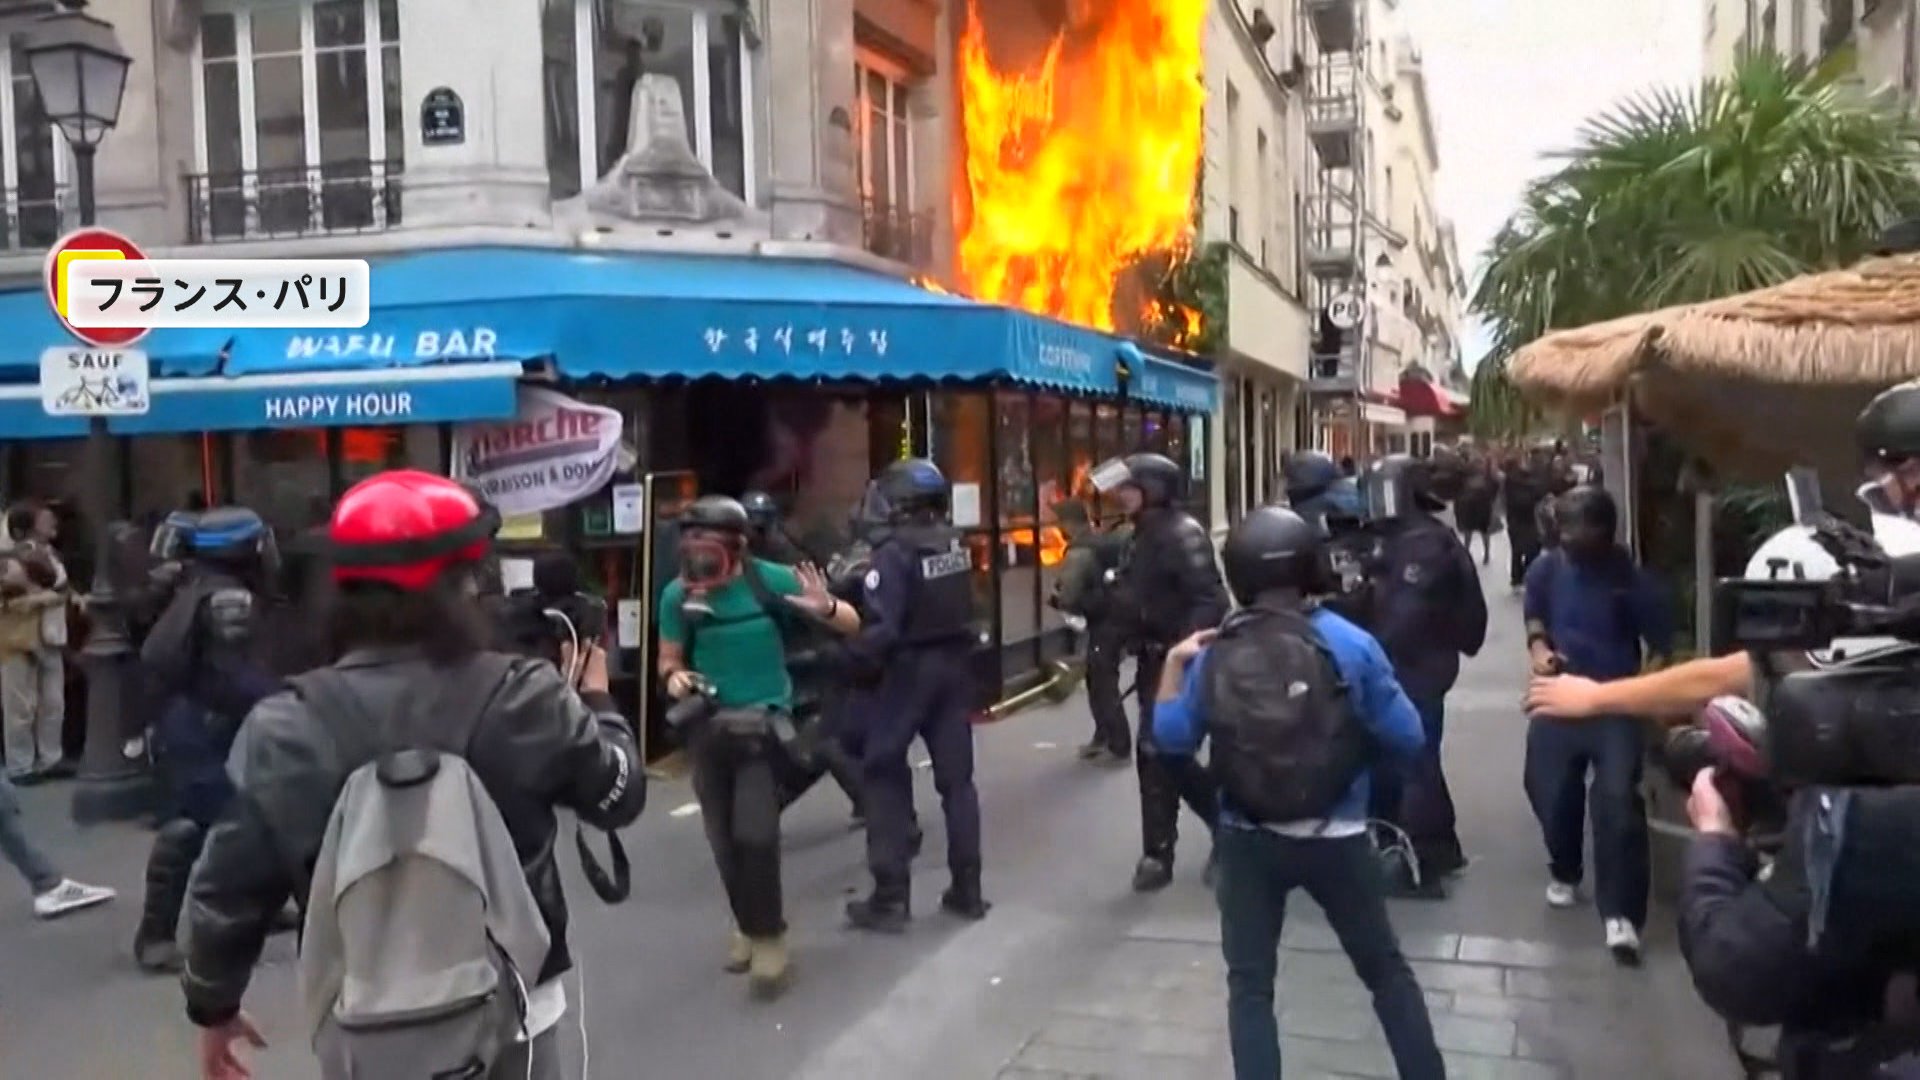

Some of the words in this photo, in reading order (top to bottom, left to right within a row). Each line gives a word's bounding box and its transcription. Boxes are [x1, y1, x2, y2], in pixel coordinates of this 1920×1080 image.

[415, 328, 498, 359] BAR
[67, 352, 123, 369] SAUF
[265, 394, 339, 420] HAPPY
[346, 391, 413, 417] HOUR
